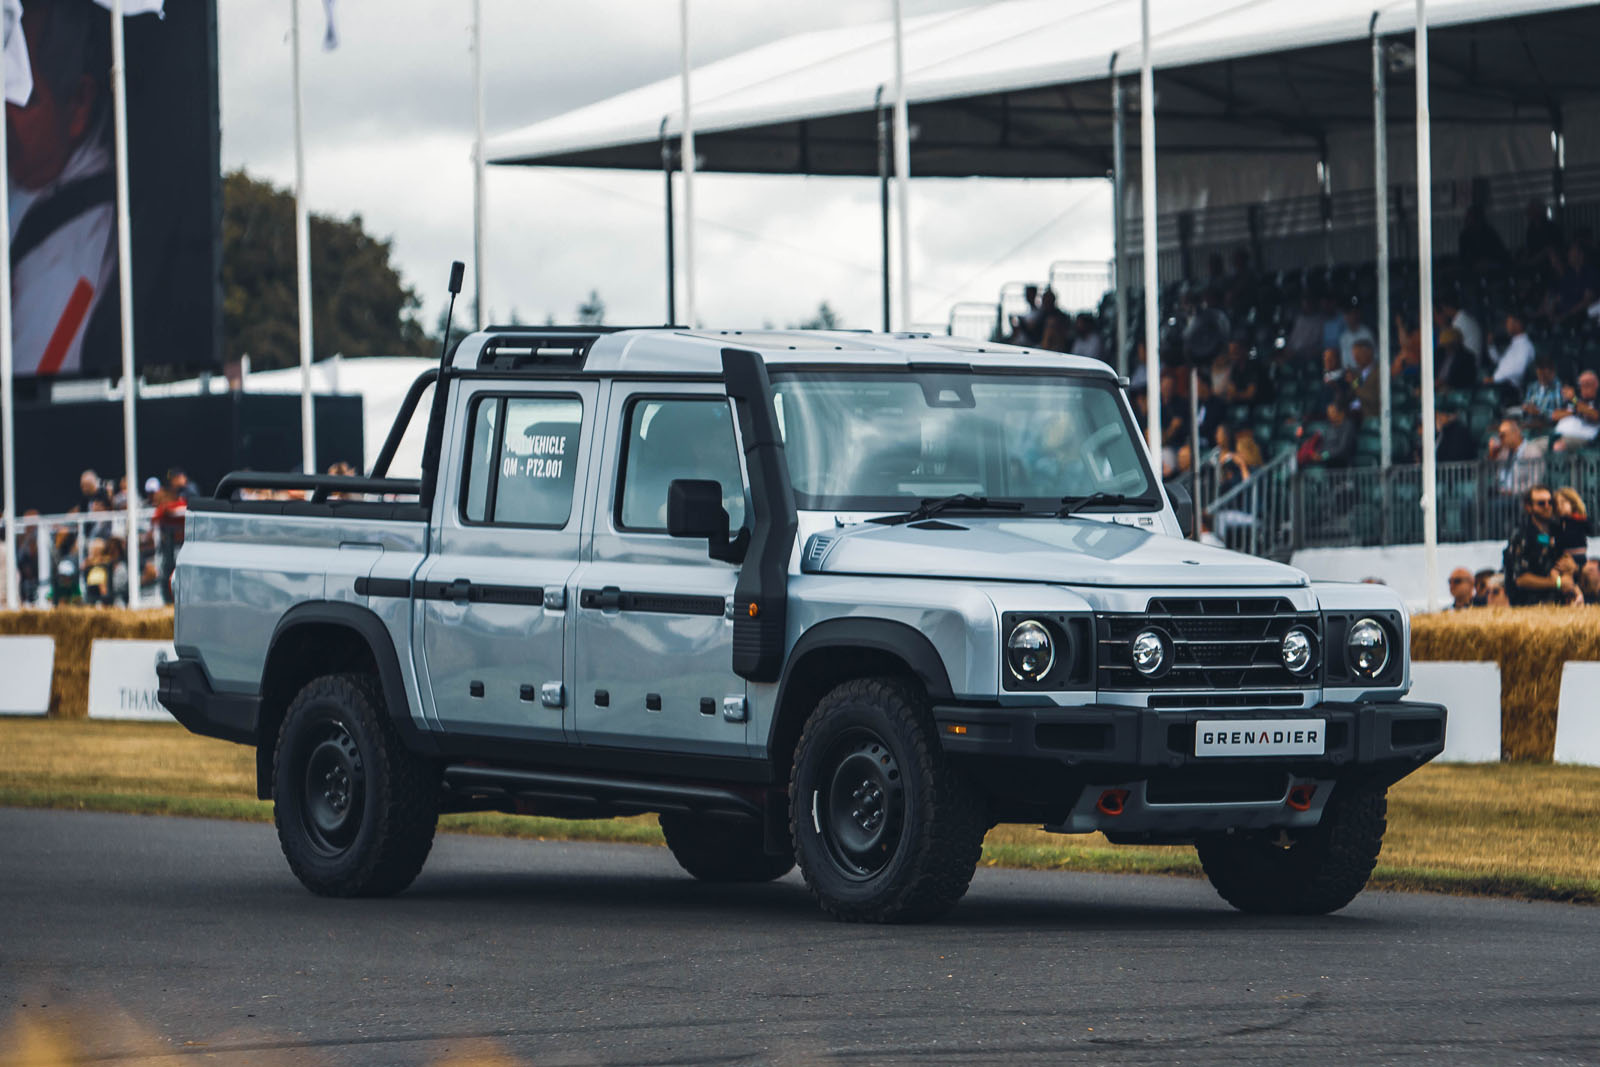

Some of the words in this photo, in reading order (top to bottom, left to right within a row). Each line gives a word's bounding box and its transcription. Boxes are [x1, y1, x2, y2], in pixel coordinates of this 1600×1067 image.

[529, 435, 566, 455] VEHICLE
[503, 457, 518, 478] QM
[526, 458, 563, 478] PT2.001
[119, 687, 166, 712] THAK
[1203, 731, 1318, 745] GRENADIER
